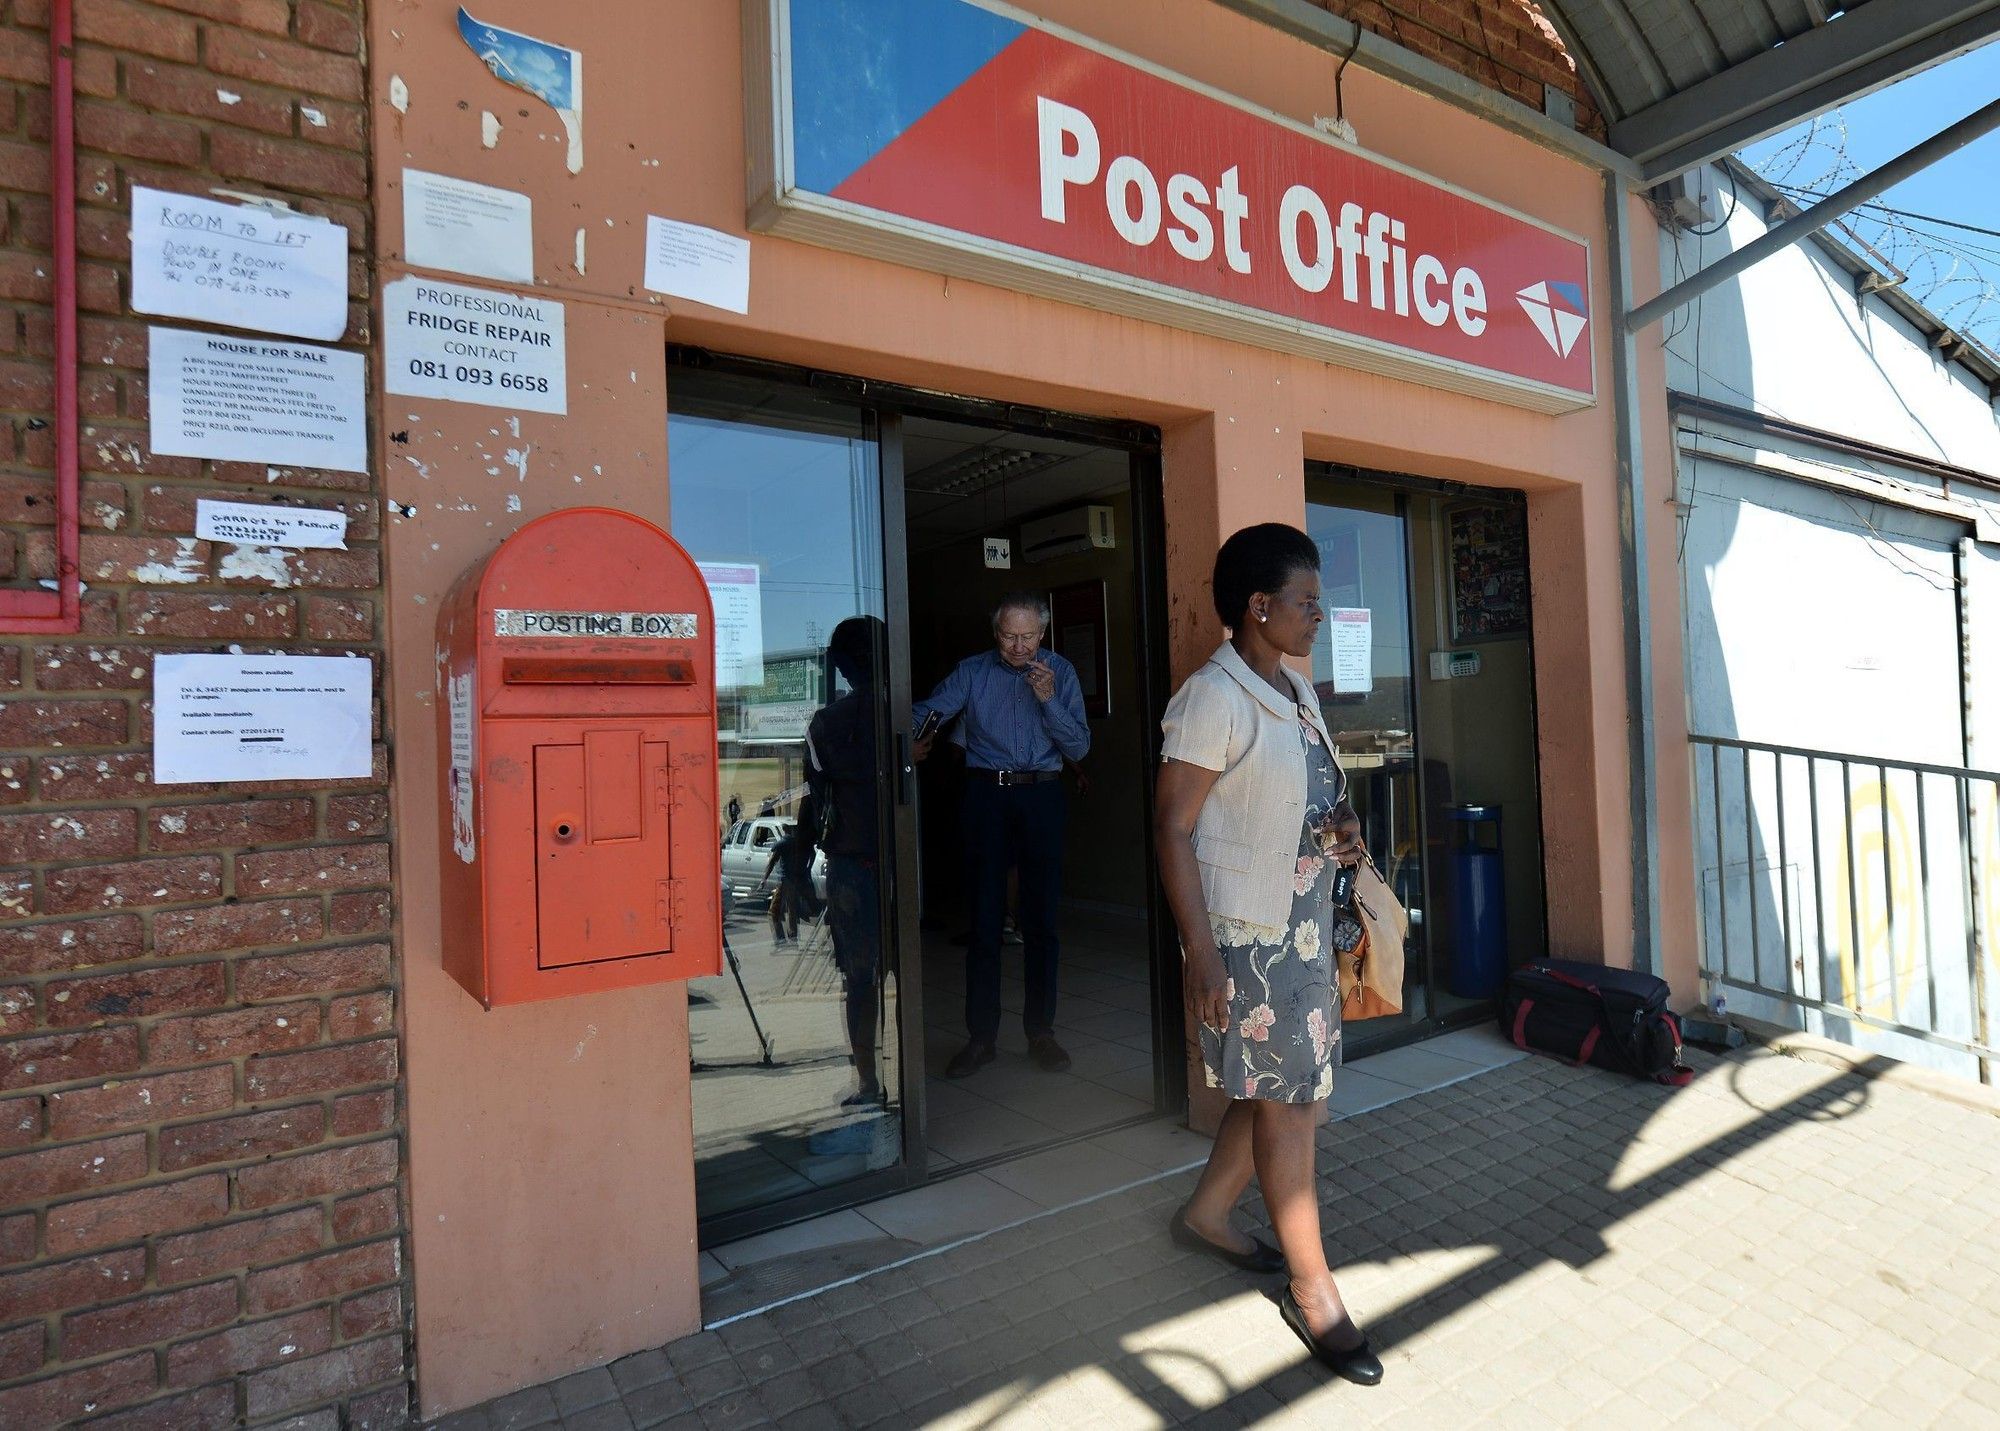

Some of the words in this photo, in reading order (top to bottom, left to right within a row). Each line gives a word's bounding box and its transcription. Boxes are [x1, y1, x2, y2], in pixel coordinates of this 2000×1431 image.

[160, 207, 222, 231] ROOM
[238, 222, 257, 237] TO
[275, 230, 312, 245] LET
[1037, 95, 1252, 274] Post
[1278, 183, 1487, 338] Office
[162, 240, 220, 259] DOUBLE
[232, 252, 286, 271] ROOMS
[229, 266, 259, 280] ONE
[416, 287, 545, 323] PROFESSIONAL
[407, 310, 479, 336] FRIDGE
[485, 323, 552, 347] REPAIR
[207, 340, 258, 356] HOUSE
[262, 347, 289, 358] FOR
[293, 350, 328, 363] SALE
[443, 340, 519, 363] CONTACT
[208, 359, 236, 368] HOUSE
[238, 363, 254, 371] FOR
[256, 365, 274, 373] SALE
[409, 359, 449, 380] 081
[455, 366, 493, 386] 093
[500, 372, 549, 394] 6658
[182, 378, 211, 387] HOUSE
[213, 380, 255, 391] ROUNDED
[257, 386, 278, 394] WITH
[280, 388, 304, 398] THREE
[260, 375, 288, 384] STREET
[182, 387, 236, 399] VANDALIZED
[307, 402, 324, 410] FREE
[325, 404, 336, 412] TO
[182, 398, 222, 408] CONTACT
[224, 402, 239, 410] MR
[182, 407, 196, 415] OR
[182, 419, 206, 428] PRICE
[233, 425, 249, 433] 000
[250, 426, 294, 437] INCLUDING
[296, 431, 335, 442] TRANSFER
[183, 430, 205, 438] COST
[524, 615, 622, 633] POSTING
[631, 617, 674, 634] BOX
